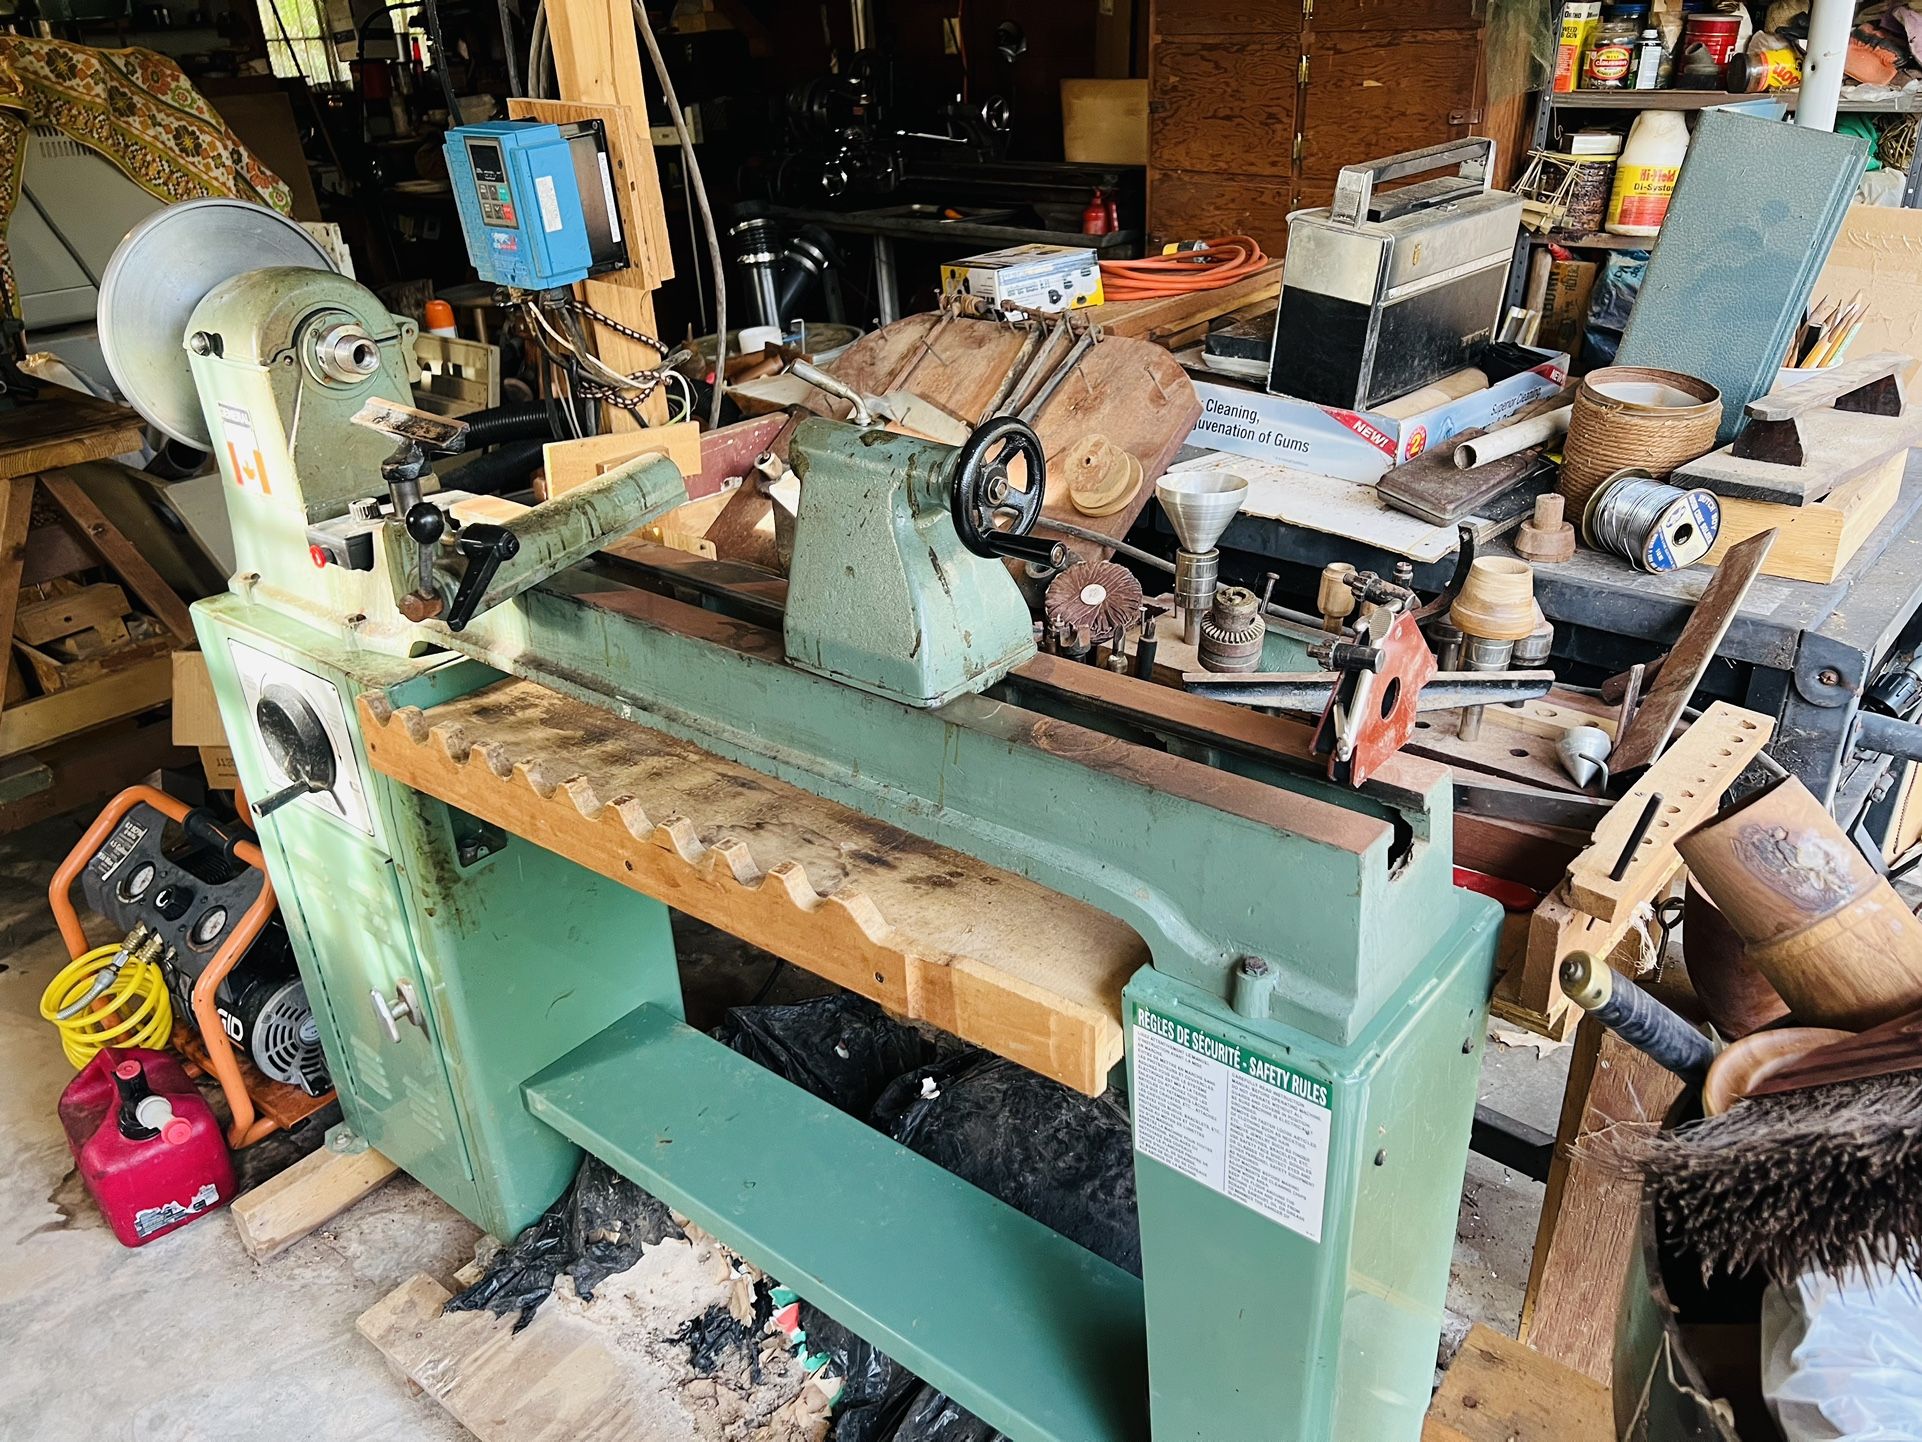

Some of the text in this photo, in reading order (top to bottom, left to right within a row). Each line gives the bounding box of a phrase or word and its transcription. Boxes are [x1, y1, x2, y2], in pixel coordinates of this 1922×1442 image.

[1206, 398, 1260, 424] Cleaning,
[1258, 430, 1273, 443] of
[1274, 433, 1310, 453] Gums
[1352, 420, 1389, 448] NEW!
[1138, 1006, 1175, 1041] RÈGLES
[1176, 1024, 1190, 1047] DE
[1191, 1030, 1241, 1070] SÉCURITÉ
[1249, 1056, 1290, 1091] SAFETY
[1291, 1073, 1329, 1107] RULES
